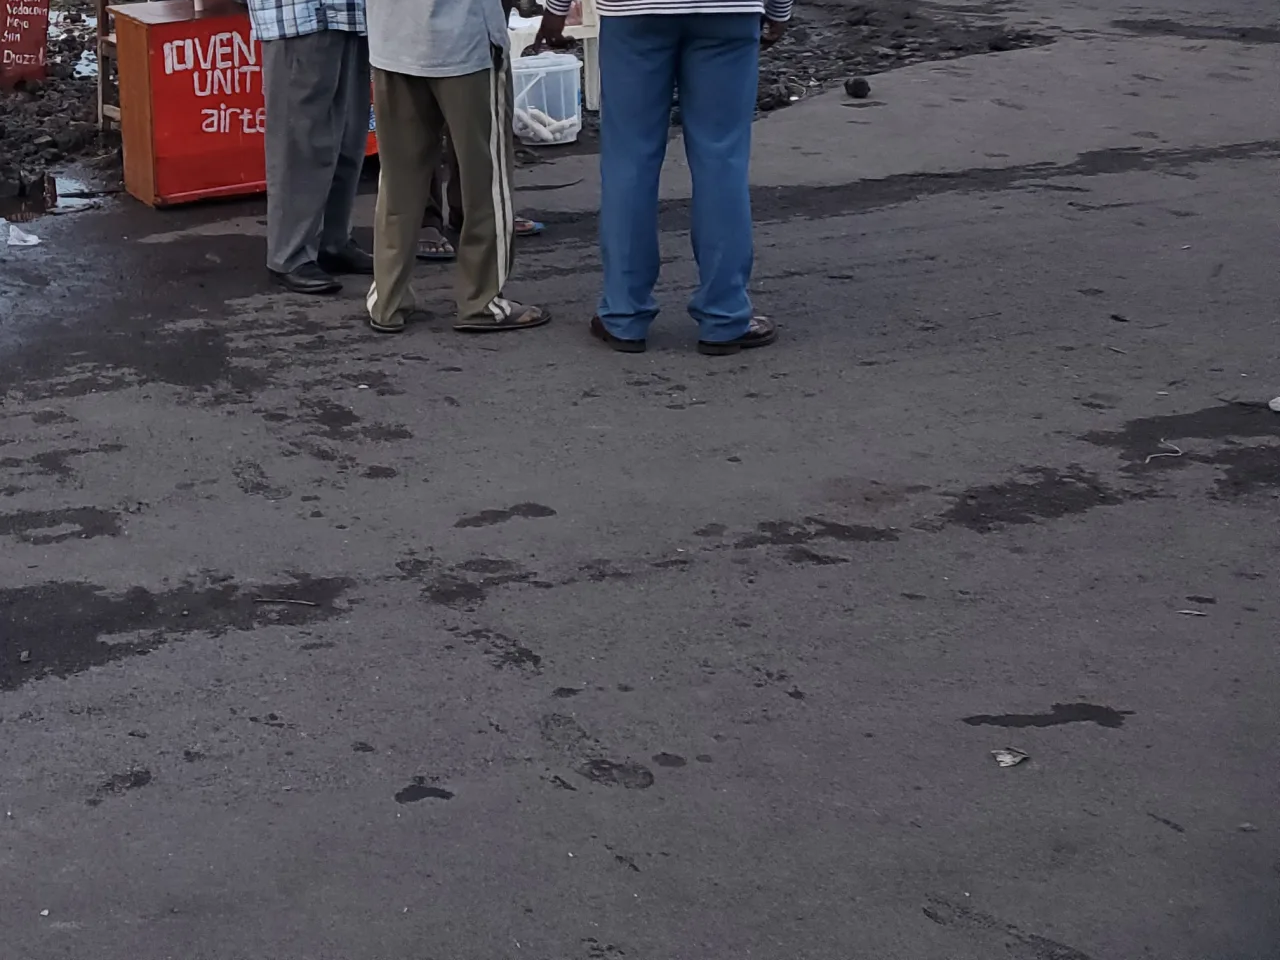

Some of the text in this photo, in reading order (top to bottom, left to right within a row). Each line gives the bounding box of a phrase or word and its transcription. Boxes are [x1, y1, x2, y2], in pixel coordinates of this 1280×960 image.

[194, 31, 256, 69] VEN
[193, 65, 264, 96] UNIT
[201, 103, 266, 134] airte
